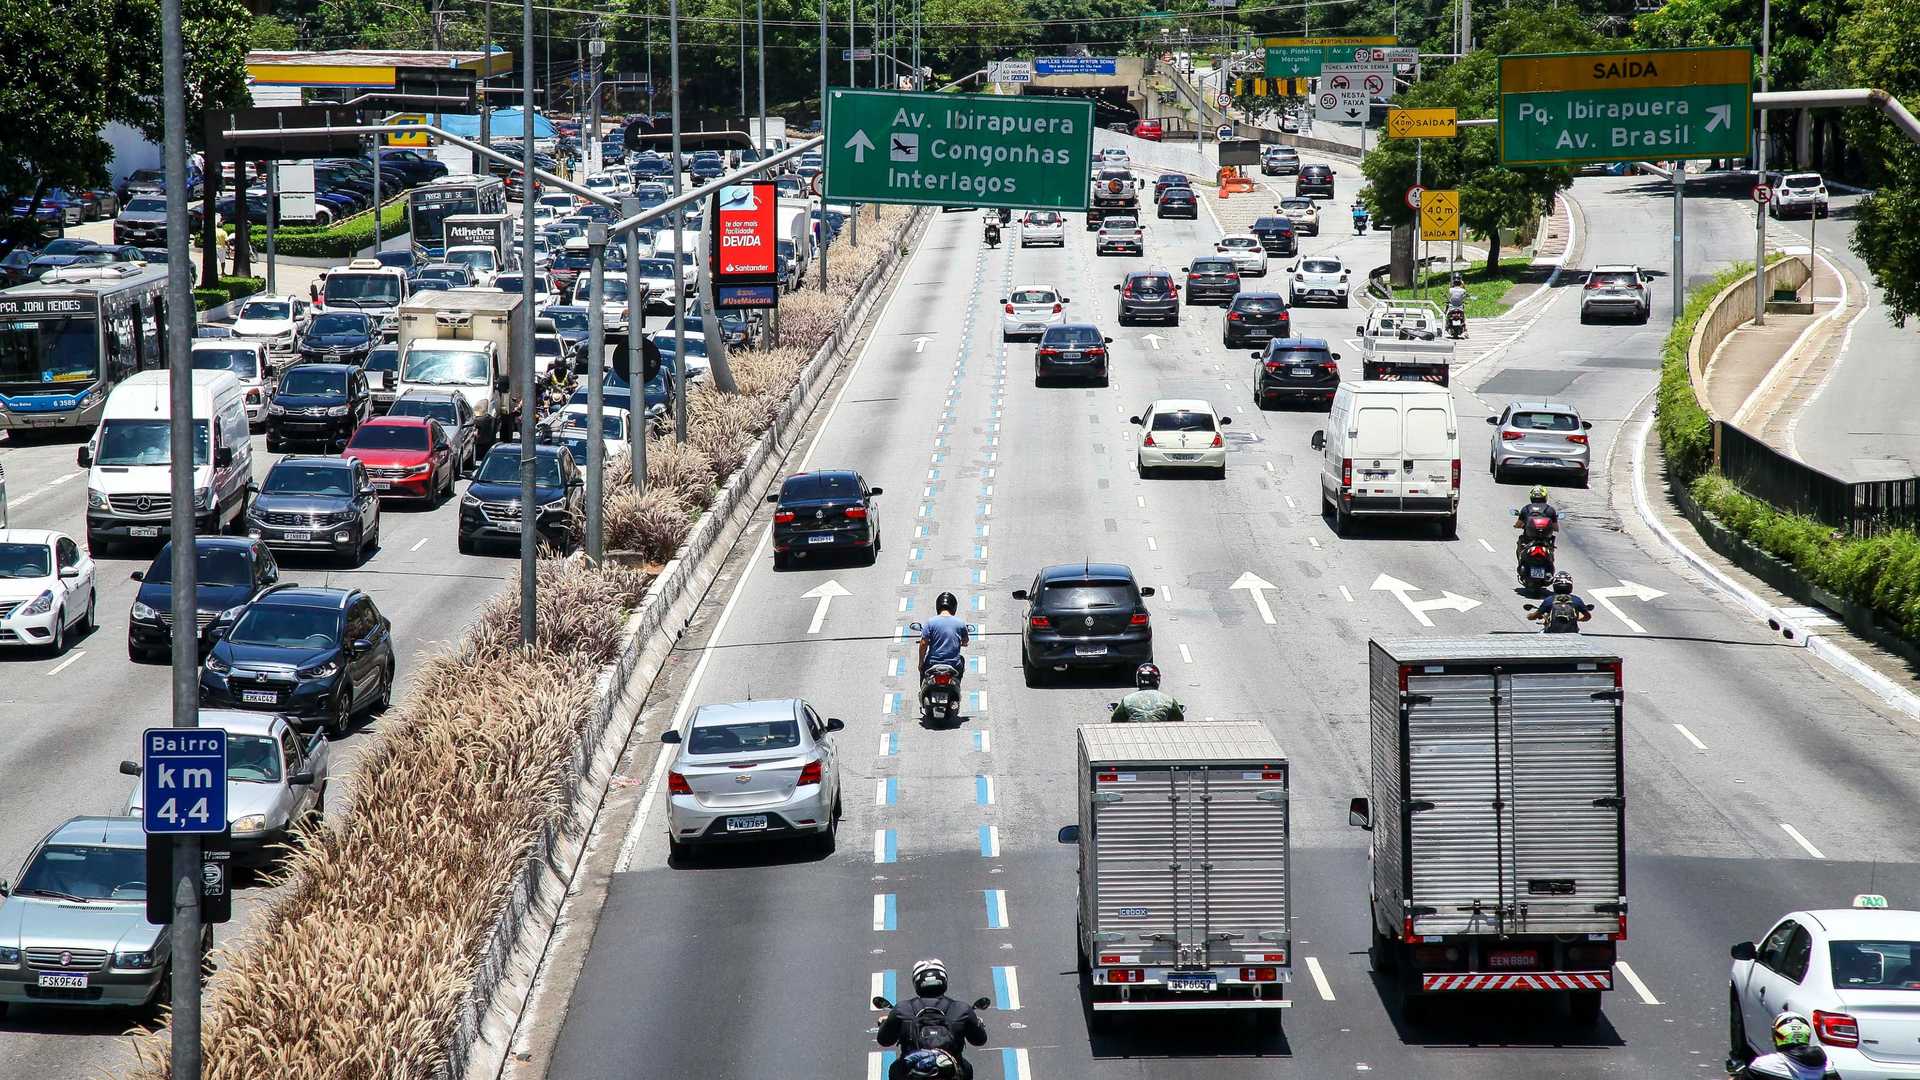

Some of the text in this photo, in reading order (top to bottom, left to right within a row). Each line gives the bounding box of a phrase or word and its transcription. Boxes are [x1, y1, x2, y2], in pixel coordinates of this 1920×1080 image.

[1291, 47, 1322, 55] Pinheiros
[1356, 51, 1368, 59] 50
[1592, 58, 1658, 80] SAÍDA
[1323, 96, 1335, 105] 50
[1519, 100, 1689, 126] Pq. Ibirapuera
[892, 107, 1074, 136] Av. Ibirapuera
[1416, 119, 1446, 127] SAÍDA
[1555, 124, 1689, 149] Av. Brasil
[931, 139, 1070, 167] Congonhas
[888, 168, 1017, 197] Interlagos
[725, 227, 754, 235] facilidade
[1423, 229, 1447, 237] SAÍDA
[722, 235, 761, 247] DEVIDA
[735, 264, 769, 272] Santander
[47, 300, 81, 312] MENDES
[722, 296, 771, 305] #UseMáscara
[152, 736, 219, 751] Bairro
[158, 763, 212, 789] km
[157, 797, 209, 827] 4,4
[42, 976, 83, 987] FSK9F46
